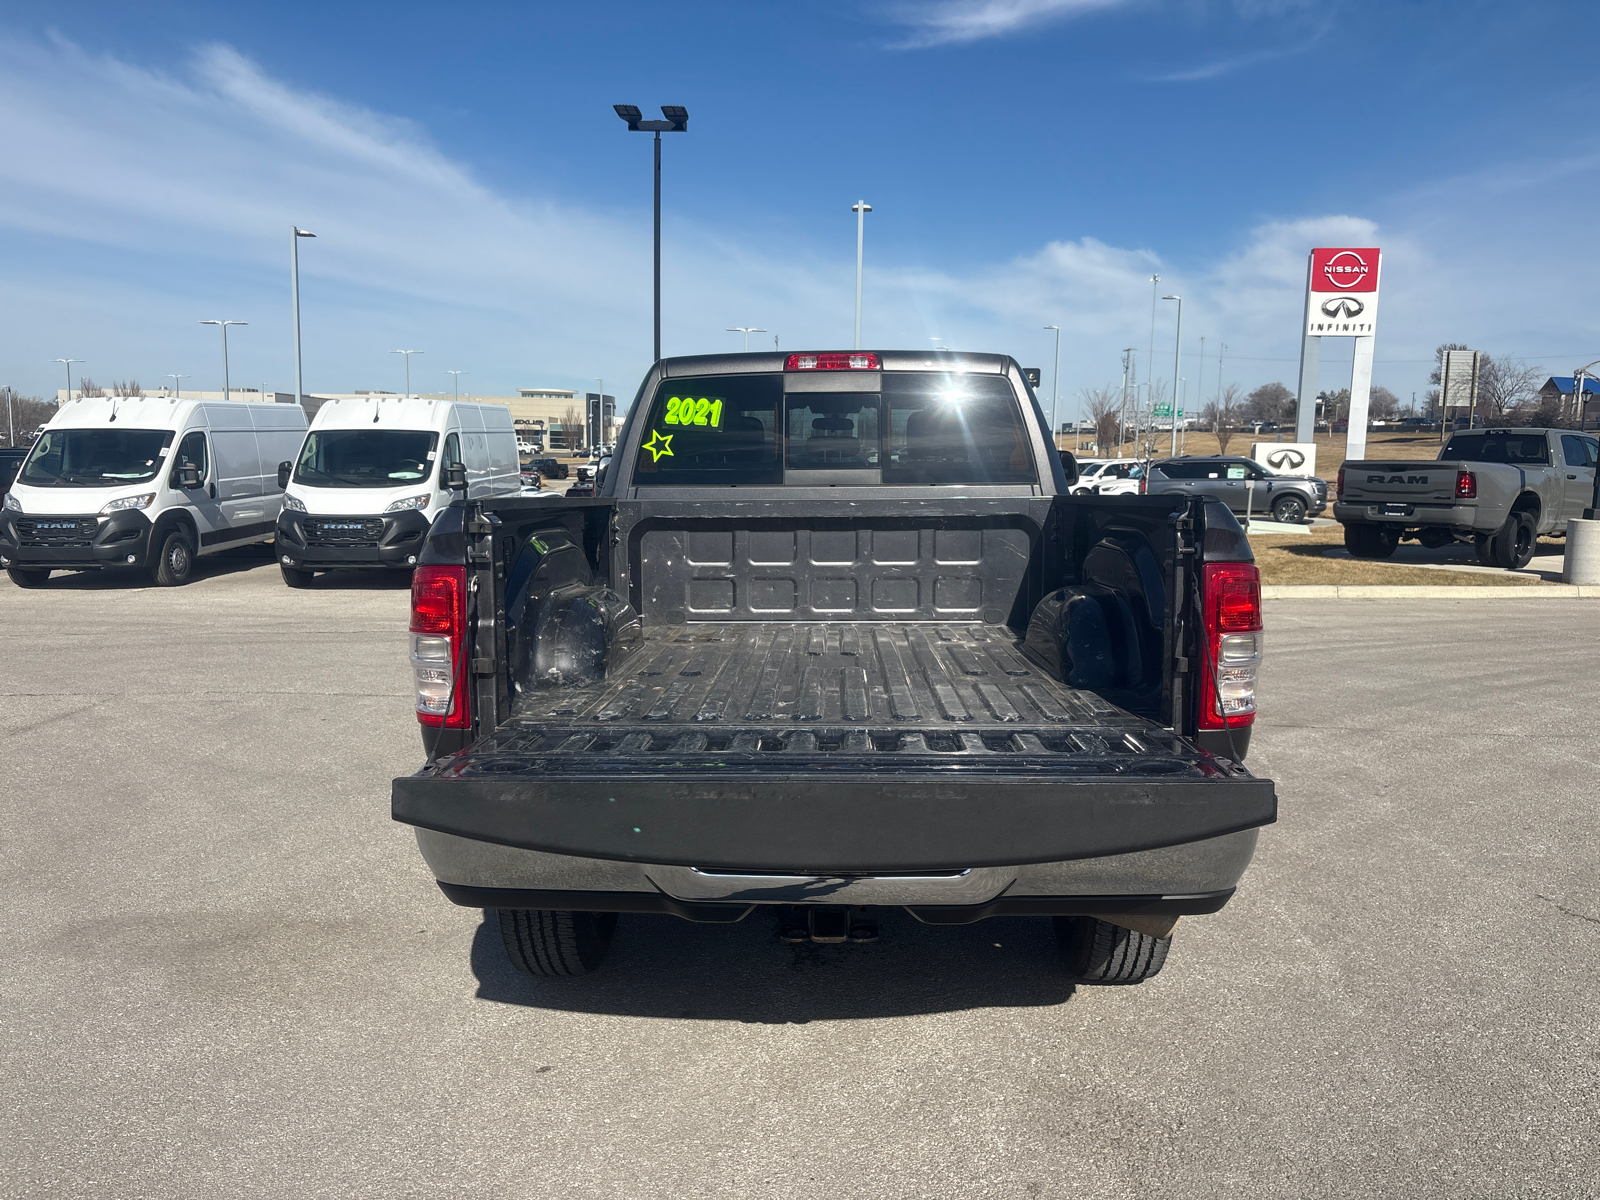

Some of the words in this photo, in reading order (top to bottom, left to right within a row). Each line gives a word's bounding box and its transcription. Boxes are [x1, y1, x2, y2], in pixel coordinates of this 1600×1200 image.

[1310, 323, 1372, 332] INFINITI
[664, 396, 723, 428] 2021
[1366, 475, 1429, 484] RAM
